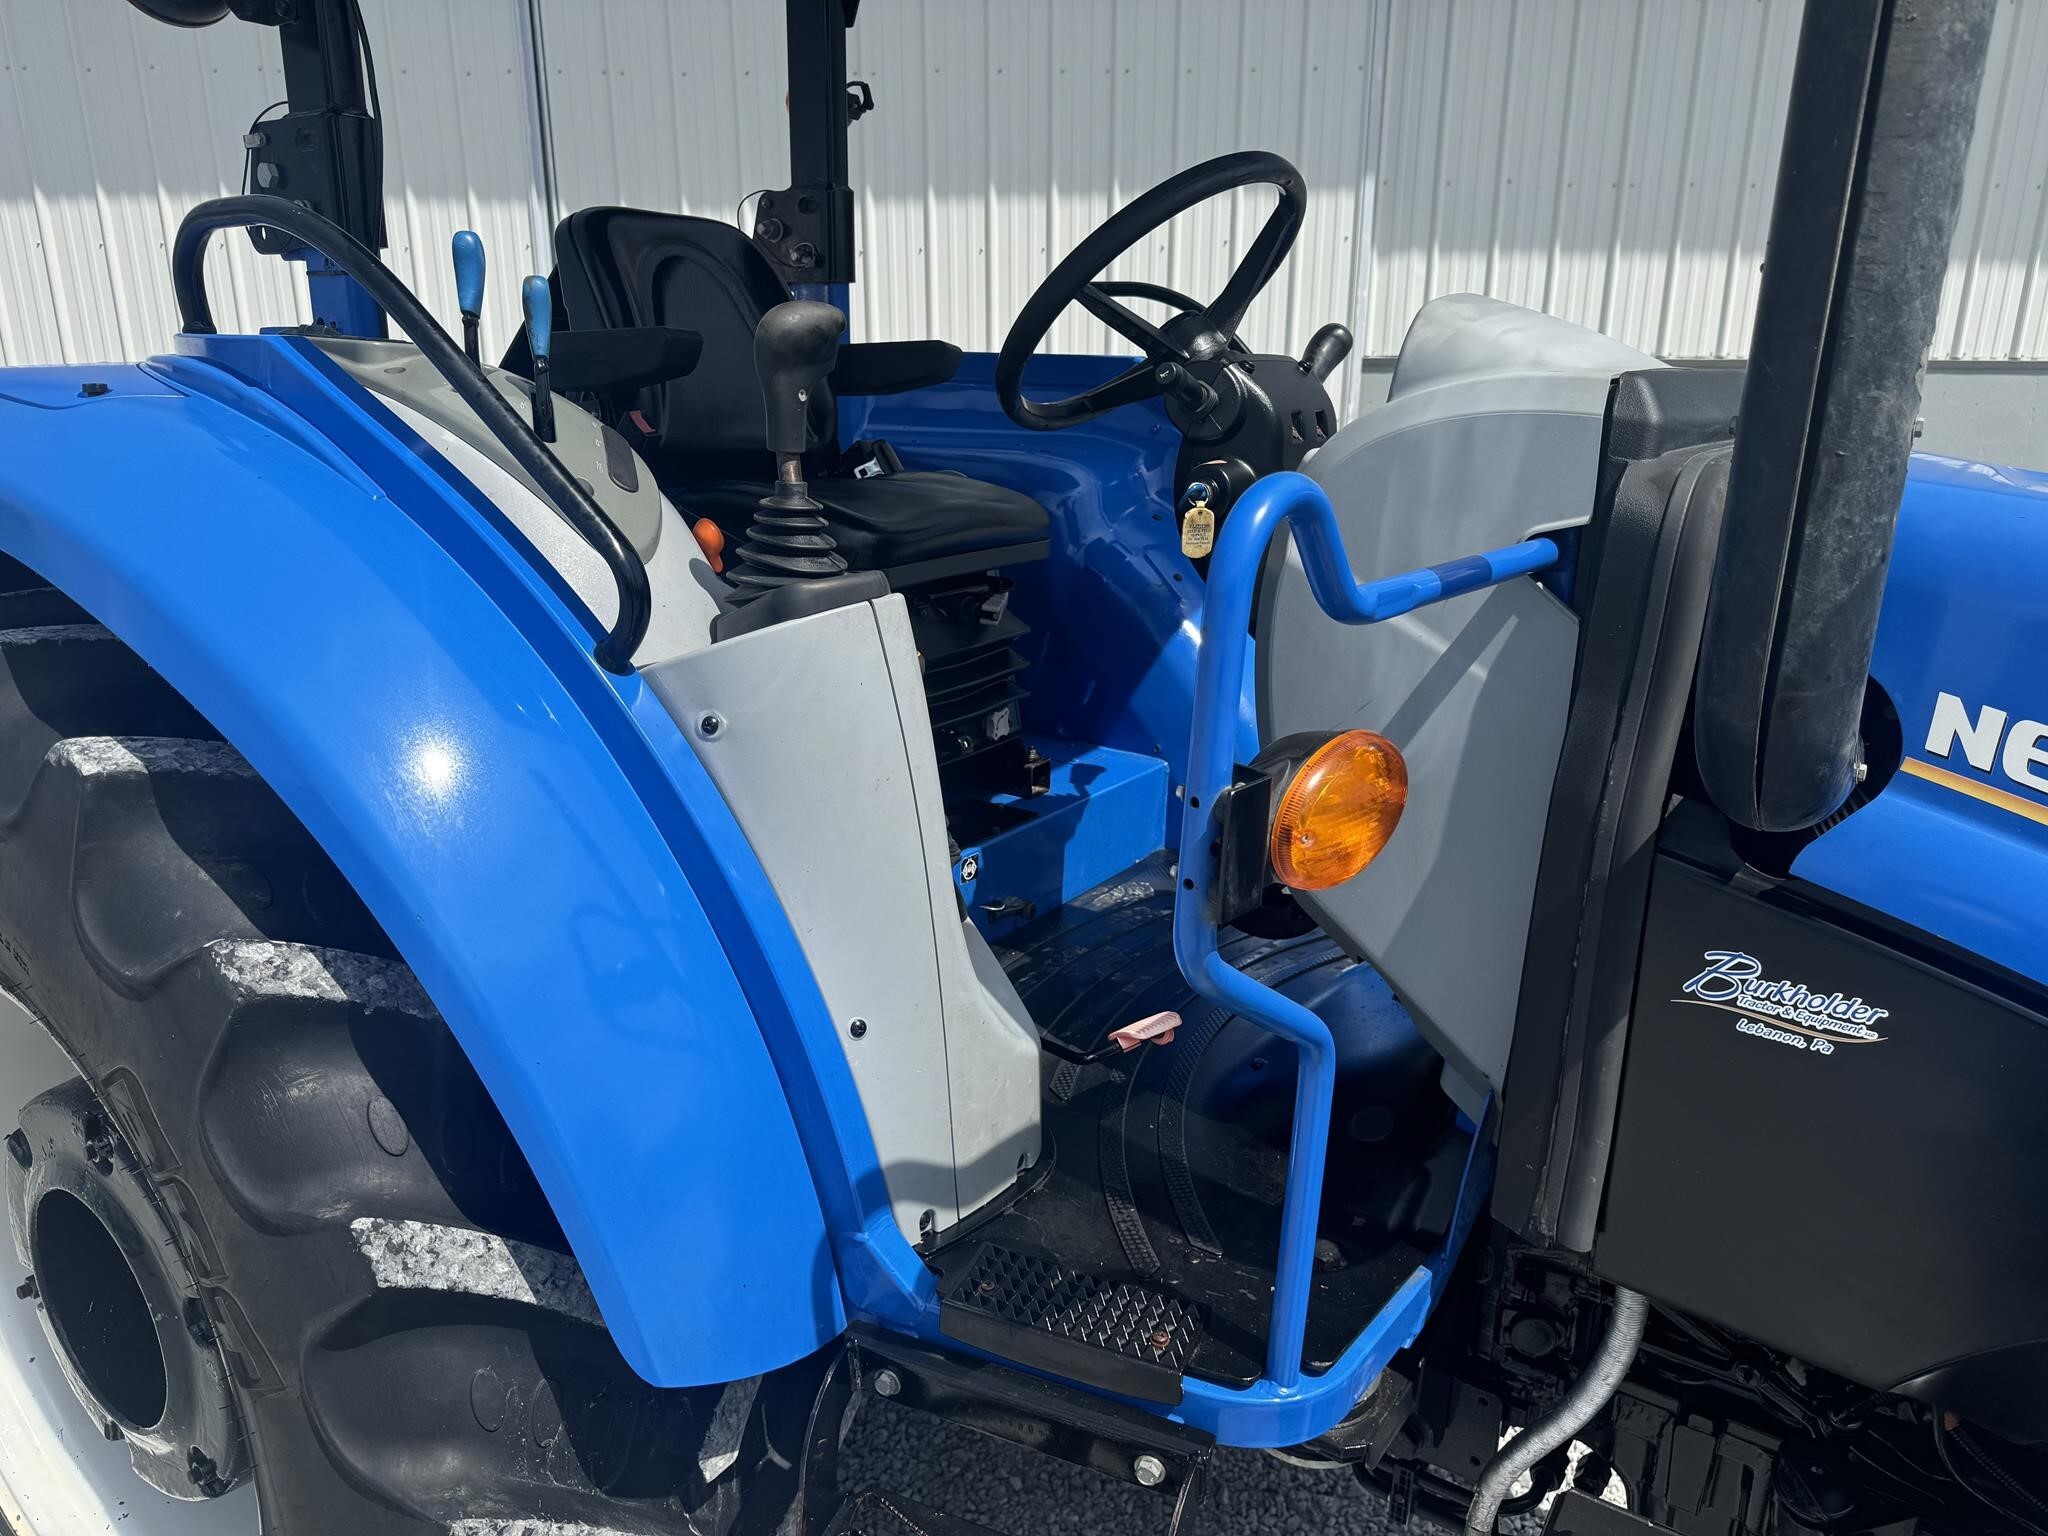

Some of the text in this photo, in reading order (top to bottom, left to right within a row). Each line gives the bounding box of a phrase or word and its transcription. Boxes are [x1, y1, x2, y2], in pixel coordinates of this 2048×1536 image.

[1683, 951, 1888, 1025] Burkholder
[1736, 1018, 1835, 1056] Lebanon, Pa
[1737, 995, 1780, 1015] Tractor
[1781, 1006, 1793, 1018] &
[1794, 1009, 1865, 1038] Equipment
